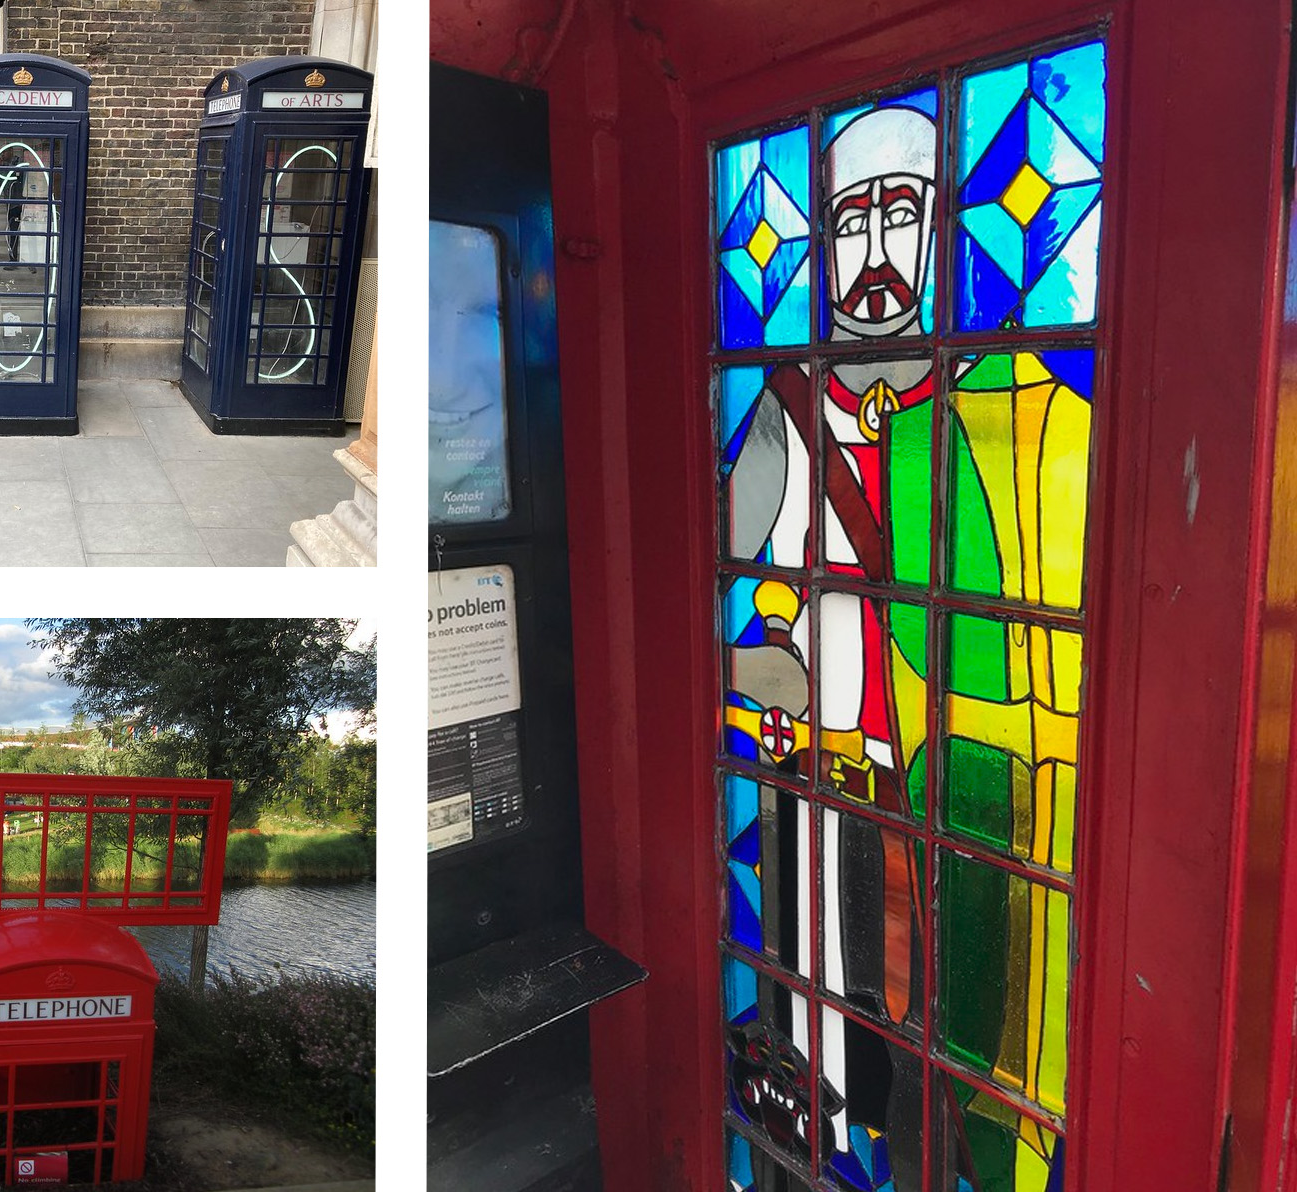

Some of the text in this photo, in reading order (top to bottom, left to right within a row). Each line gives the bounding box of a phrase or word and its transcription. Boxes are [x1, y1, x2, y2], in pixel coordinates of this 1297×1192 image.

[209, 95, 241, 113] TELEPHONE
[280, 93, 344, 107] OF ARTS
[446, 451, 485, 461] contact
[443, 490, 484, 502] Kontakt
[447, 504, 481, 515] halten
[437, 597, 506, 624] problem
[438, 627, 454, 637] not
[455, 623, 484, 634] accept
[485, 619, 508, 630] coins.
